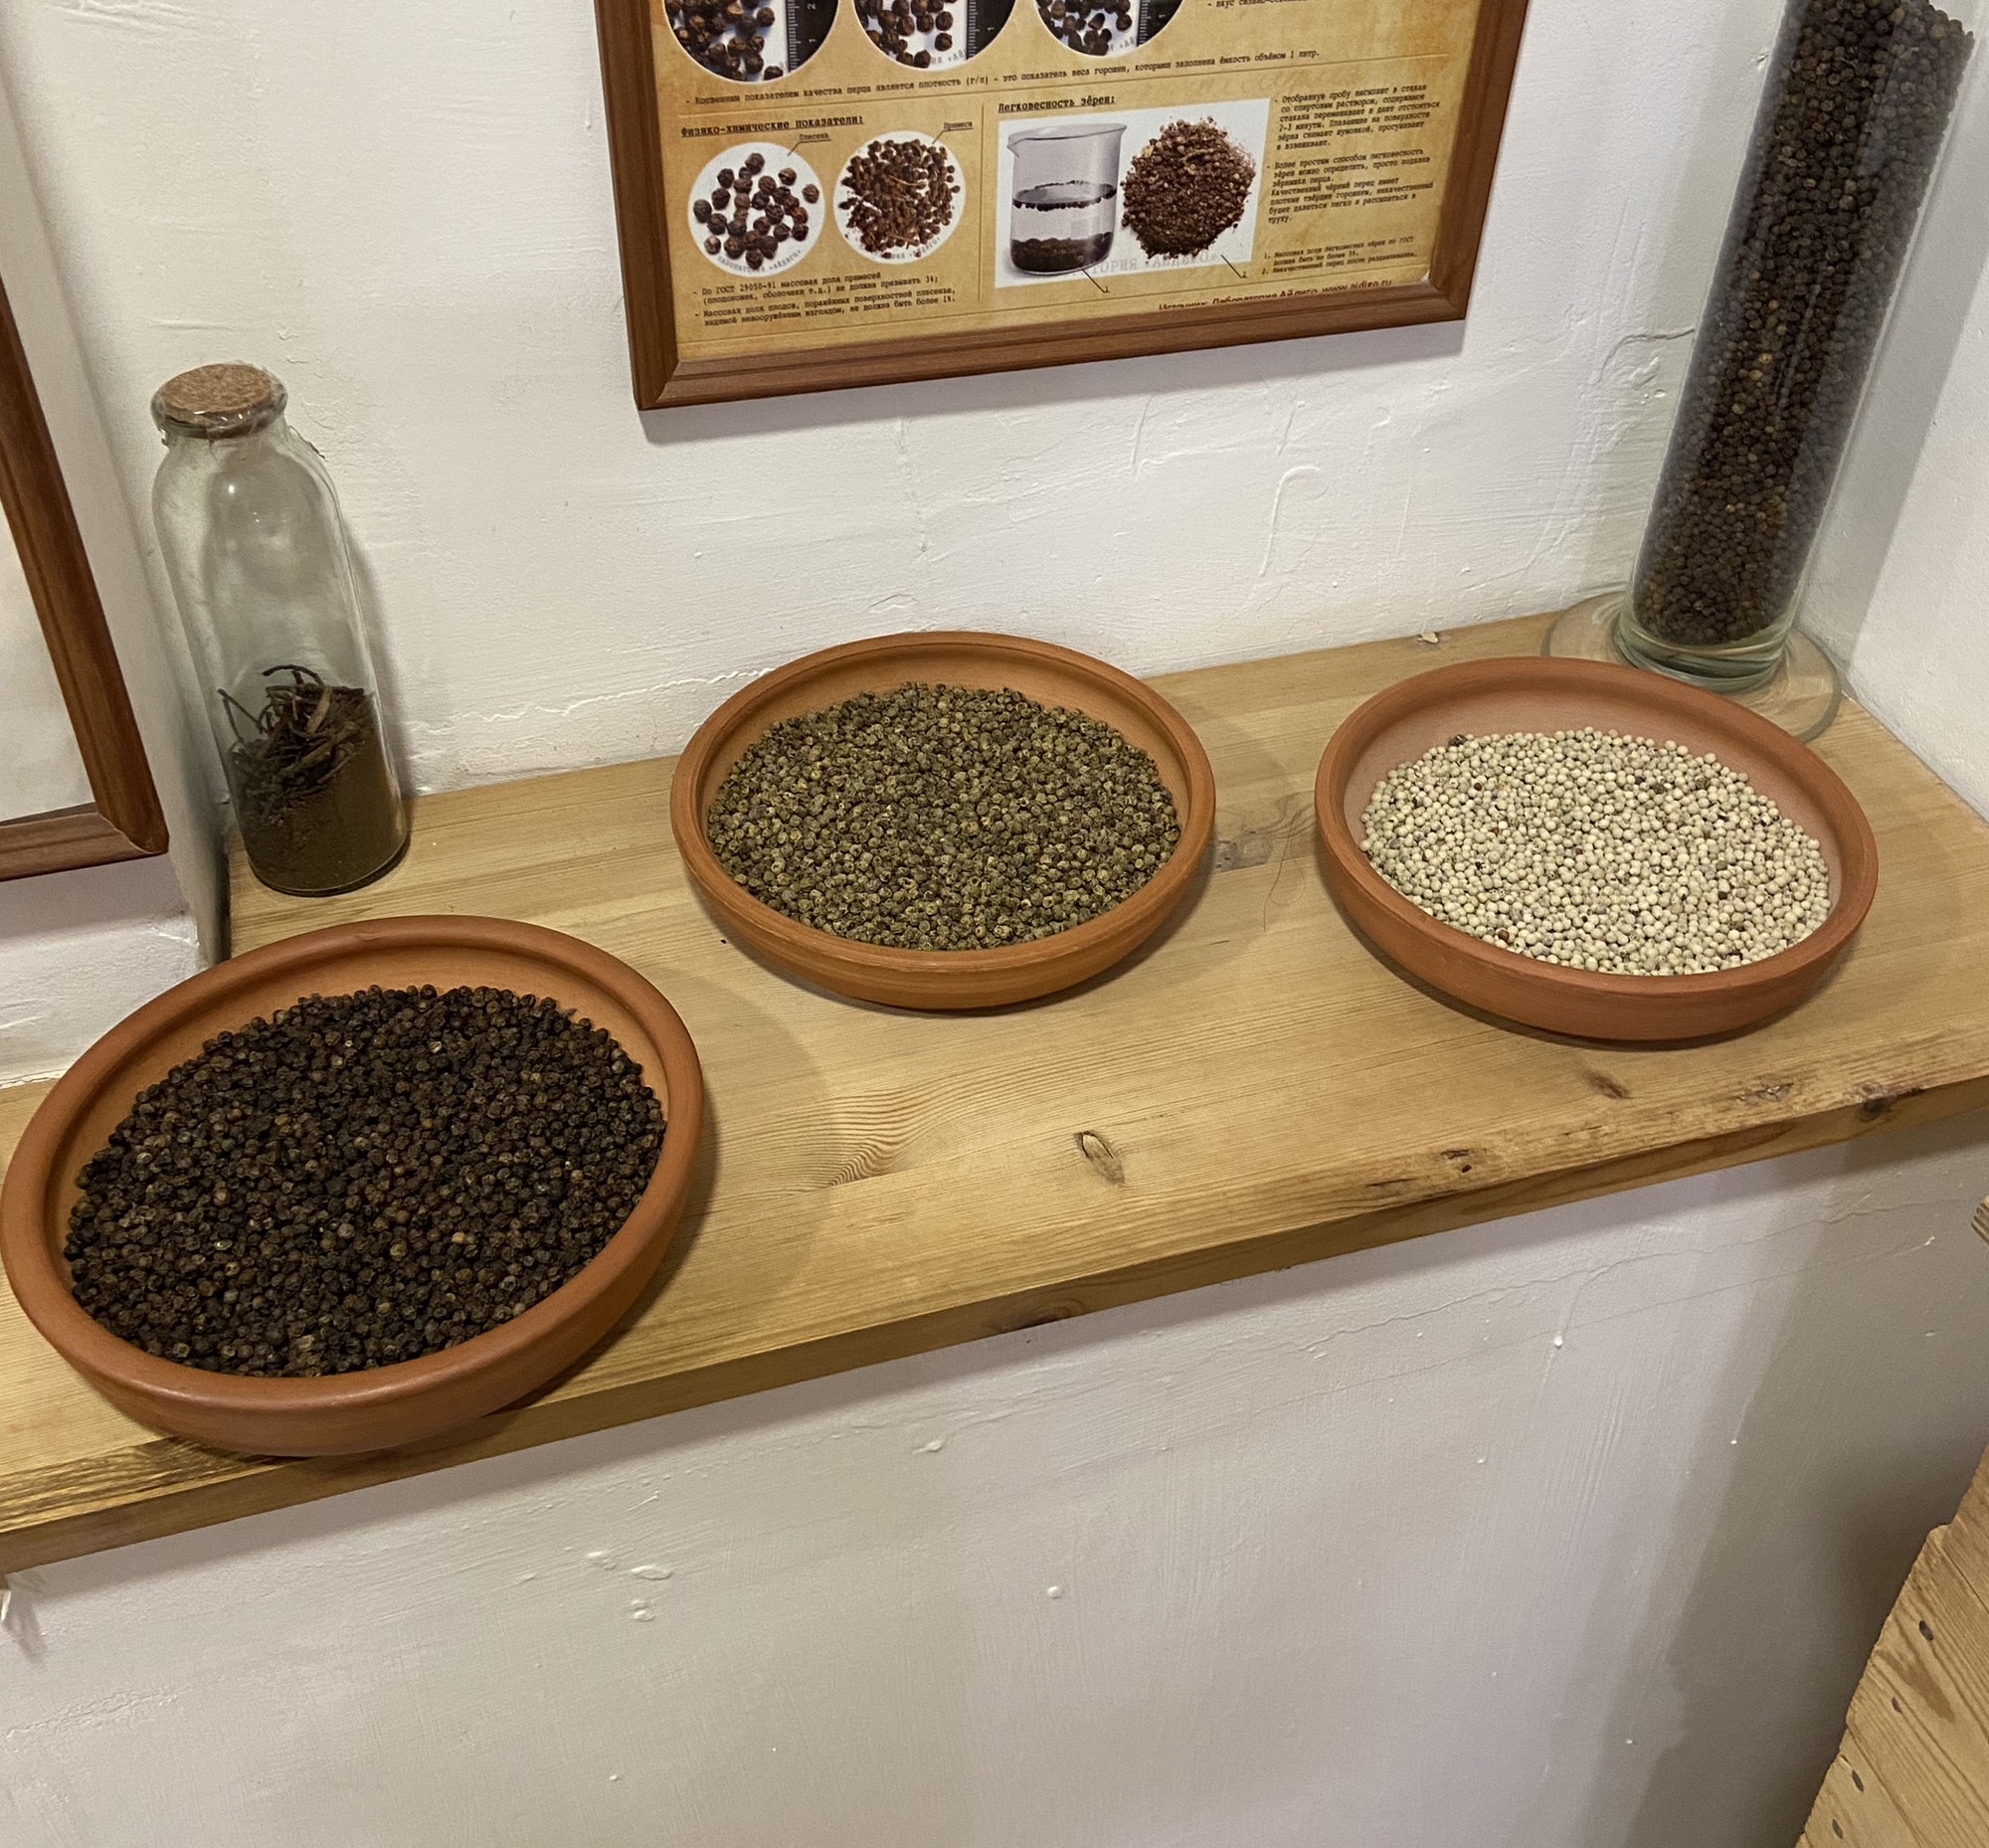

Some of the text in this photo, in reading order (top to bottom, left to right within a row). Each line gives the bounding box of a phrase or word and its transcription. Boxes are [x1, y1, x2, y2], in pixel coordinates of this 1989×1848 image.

[745, 91, 800, 100] показателем
[804, 88, 842, 96] качества
[846, 86, 871, 94] перца
[876, 83, 914, 92] является
[919, 79, 961, 89] плотность
[966, 75, 989, 86] (г/л)
[1021, 72, 1067, 82] показатель
[1095, 67, 1129, 78] горошин,
[1135, 63, 1172, 73] которыми
[1175, 59, 1215, 69] заполнена
[1255, 52, 1286, 62] объёмом
[997, 94, 1115, 113] Легковесность зёрен:
[680, 114, 863, 137] Физико-химические показатели:
